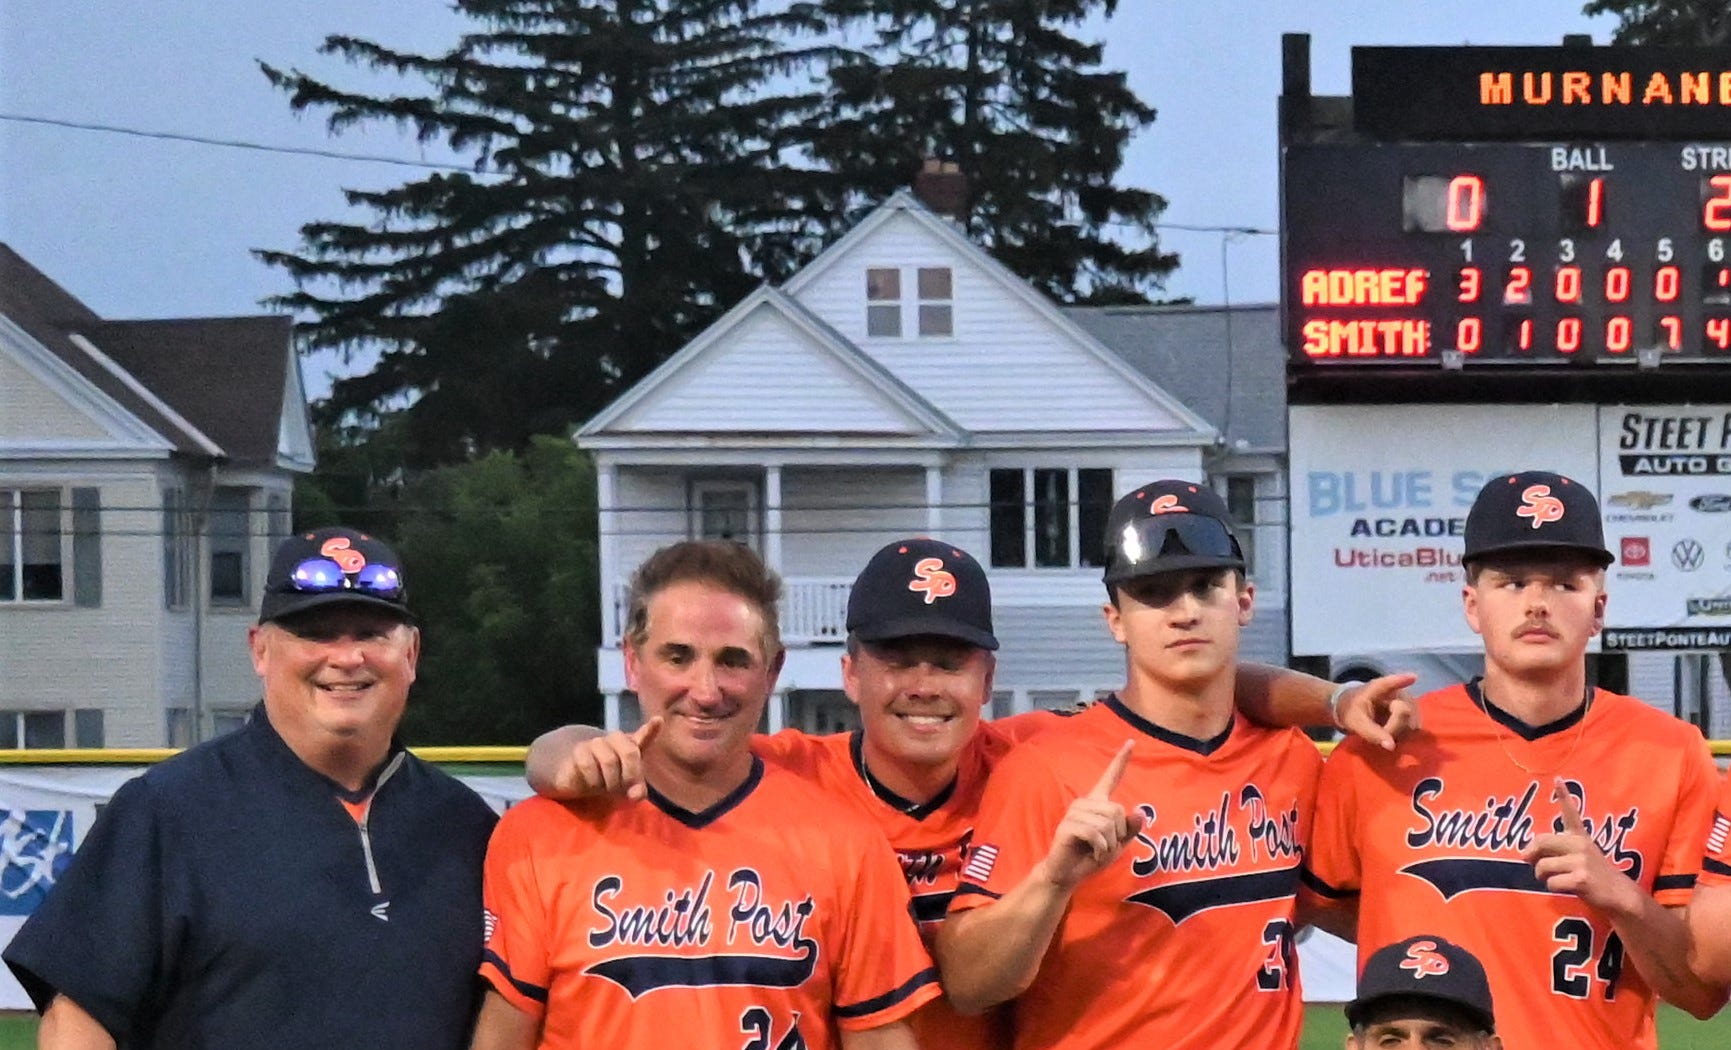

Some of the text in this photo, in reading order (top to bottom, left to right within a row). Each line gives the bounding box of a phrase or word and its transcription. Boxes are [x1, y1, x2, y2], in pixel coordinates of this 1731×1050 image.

[1551, 147, 1614, 170] BALL
[1586, 177, 1604, 228] 1
[1460, 240, 1474, 262] 1
[1509, 240, 1526, 262] 2
[1559, 240, 1576, 262] 3
[1606, 240, 1625, 262] 4
[1657, 239, 1673, 261] 5
[1708, 239, 1724, 261] 6
[1458, 266, 1481, 303] 3
[1506, 266, 1531, 303] 2
[1556, 266, 1581, 303] 0
[1606, 266, 1631, 303] 0
[1656, 266, 1680, 303] 0
[1303, 318, 1429, 356] SMITH
[1458, 316, 1481, 353] 0
[1519, 317, 1530, 351] 1
[1556, 316, 1581, 353] 0
[1606, 316, 1631, 353] 0
[1660, 316, 1681, 351] 7
[1706, 316, 1731, 350] 4
[1619, 412, 1713, 450] STEET
[1634, 457, 1708, 474] AUTO
[1308, 471, 1433, 518] BLUE
[1351, 518, 1466, 539] ACADE
[1334, 548, 1464, 568] UticaBlu
[1406, 776, 1538, 850] Smith
[1130, 790, 1240, 878] Smith
[587, 868, 713, 949] Smith
[729, 867, 817, 950] Post
[1551, 916, 1627, 1002] 24
